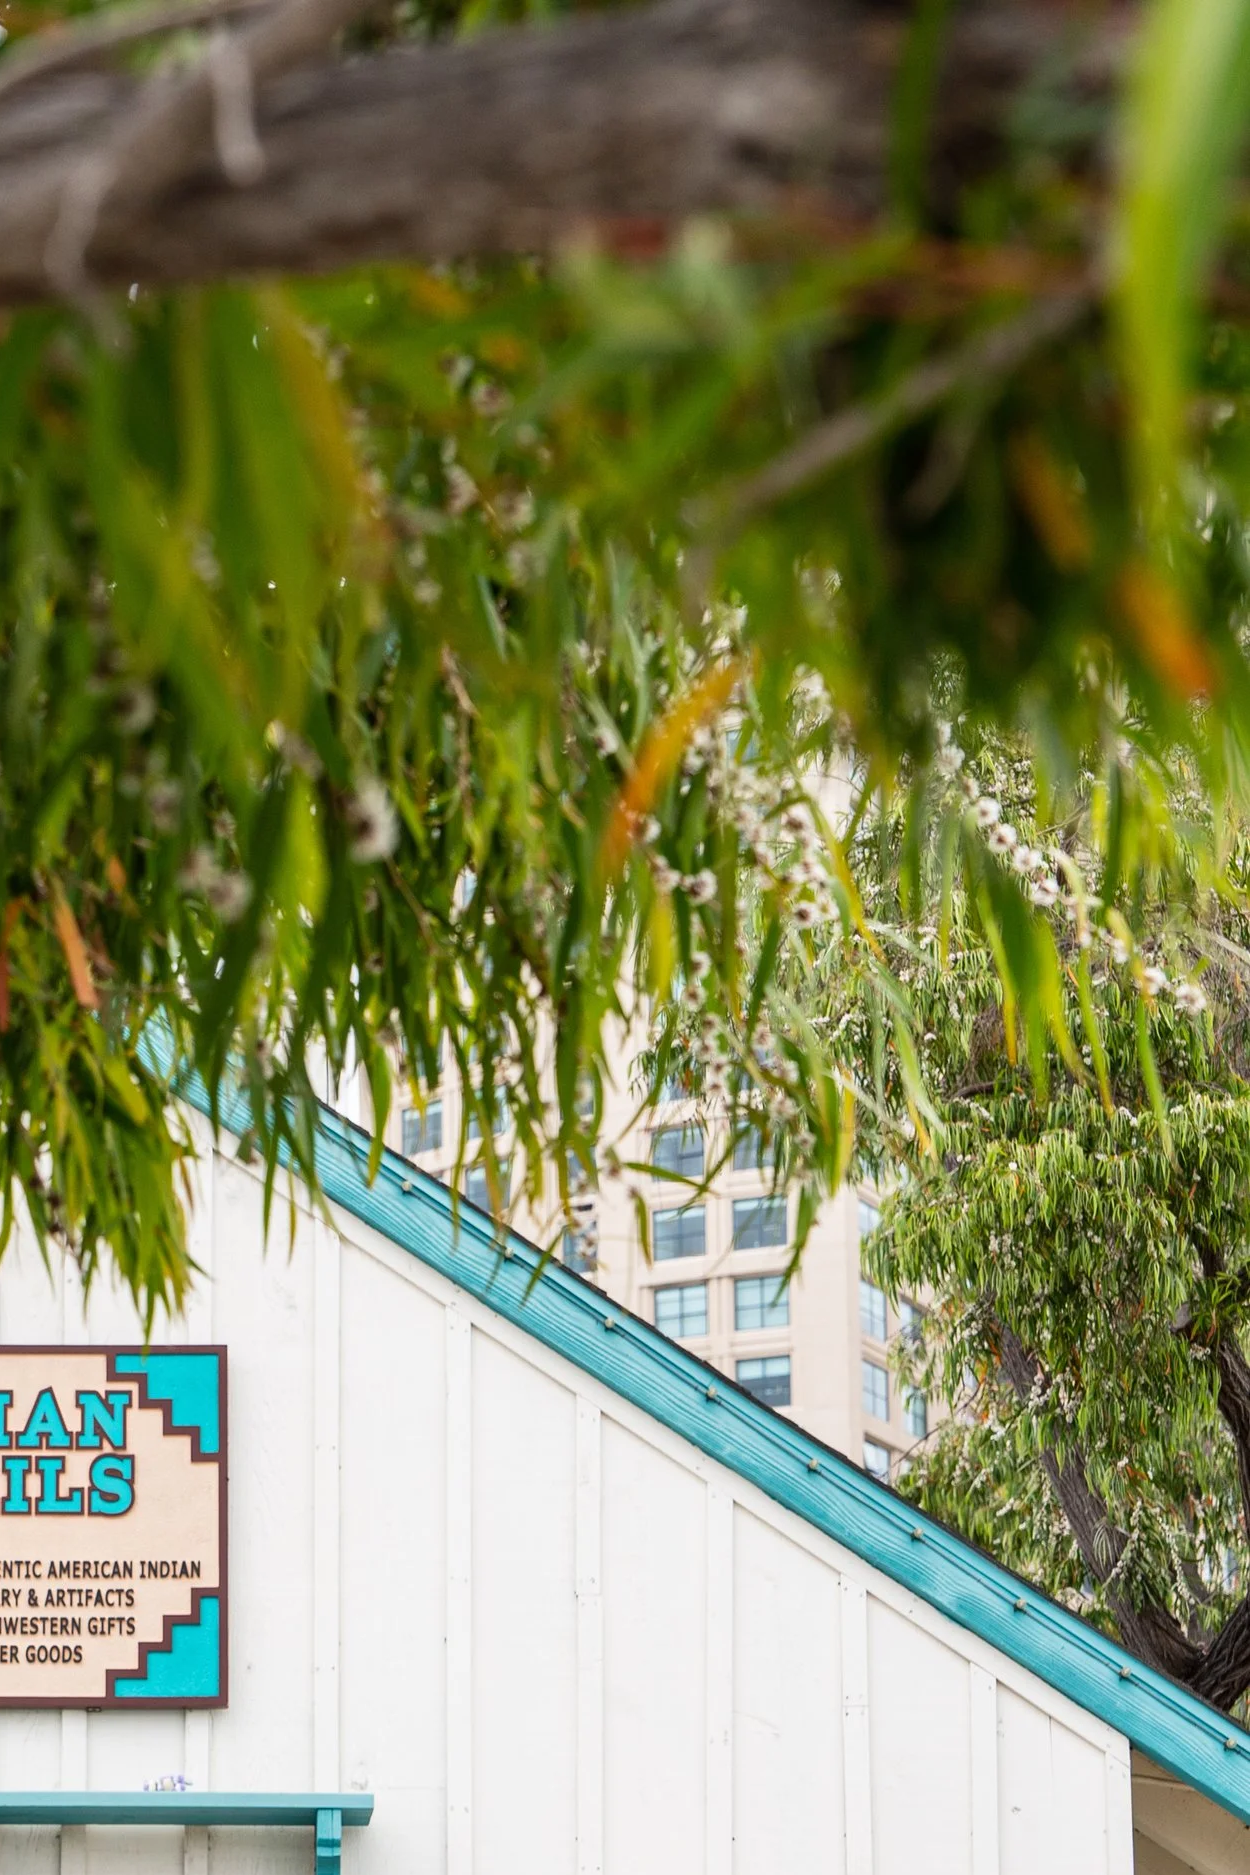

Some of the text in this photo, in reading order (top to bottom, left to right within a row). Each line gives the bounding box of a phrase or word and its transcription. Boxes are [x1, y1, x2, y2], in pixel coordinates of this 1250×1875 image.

[47, 1560, 134, 1579] AMERICAN
[139, 1560, 201, 1579] INDIAN
[28, 1588, 39, 1607] &
[44, 1588, 135, 1607] ARTIFACTS
[87, 1616, 136, 1636] GIFTS
[25, 1644, 83, 1664] GOODS
